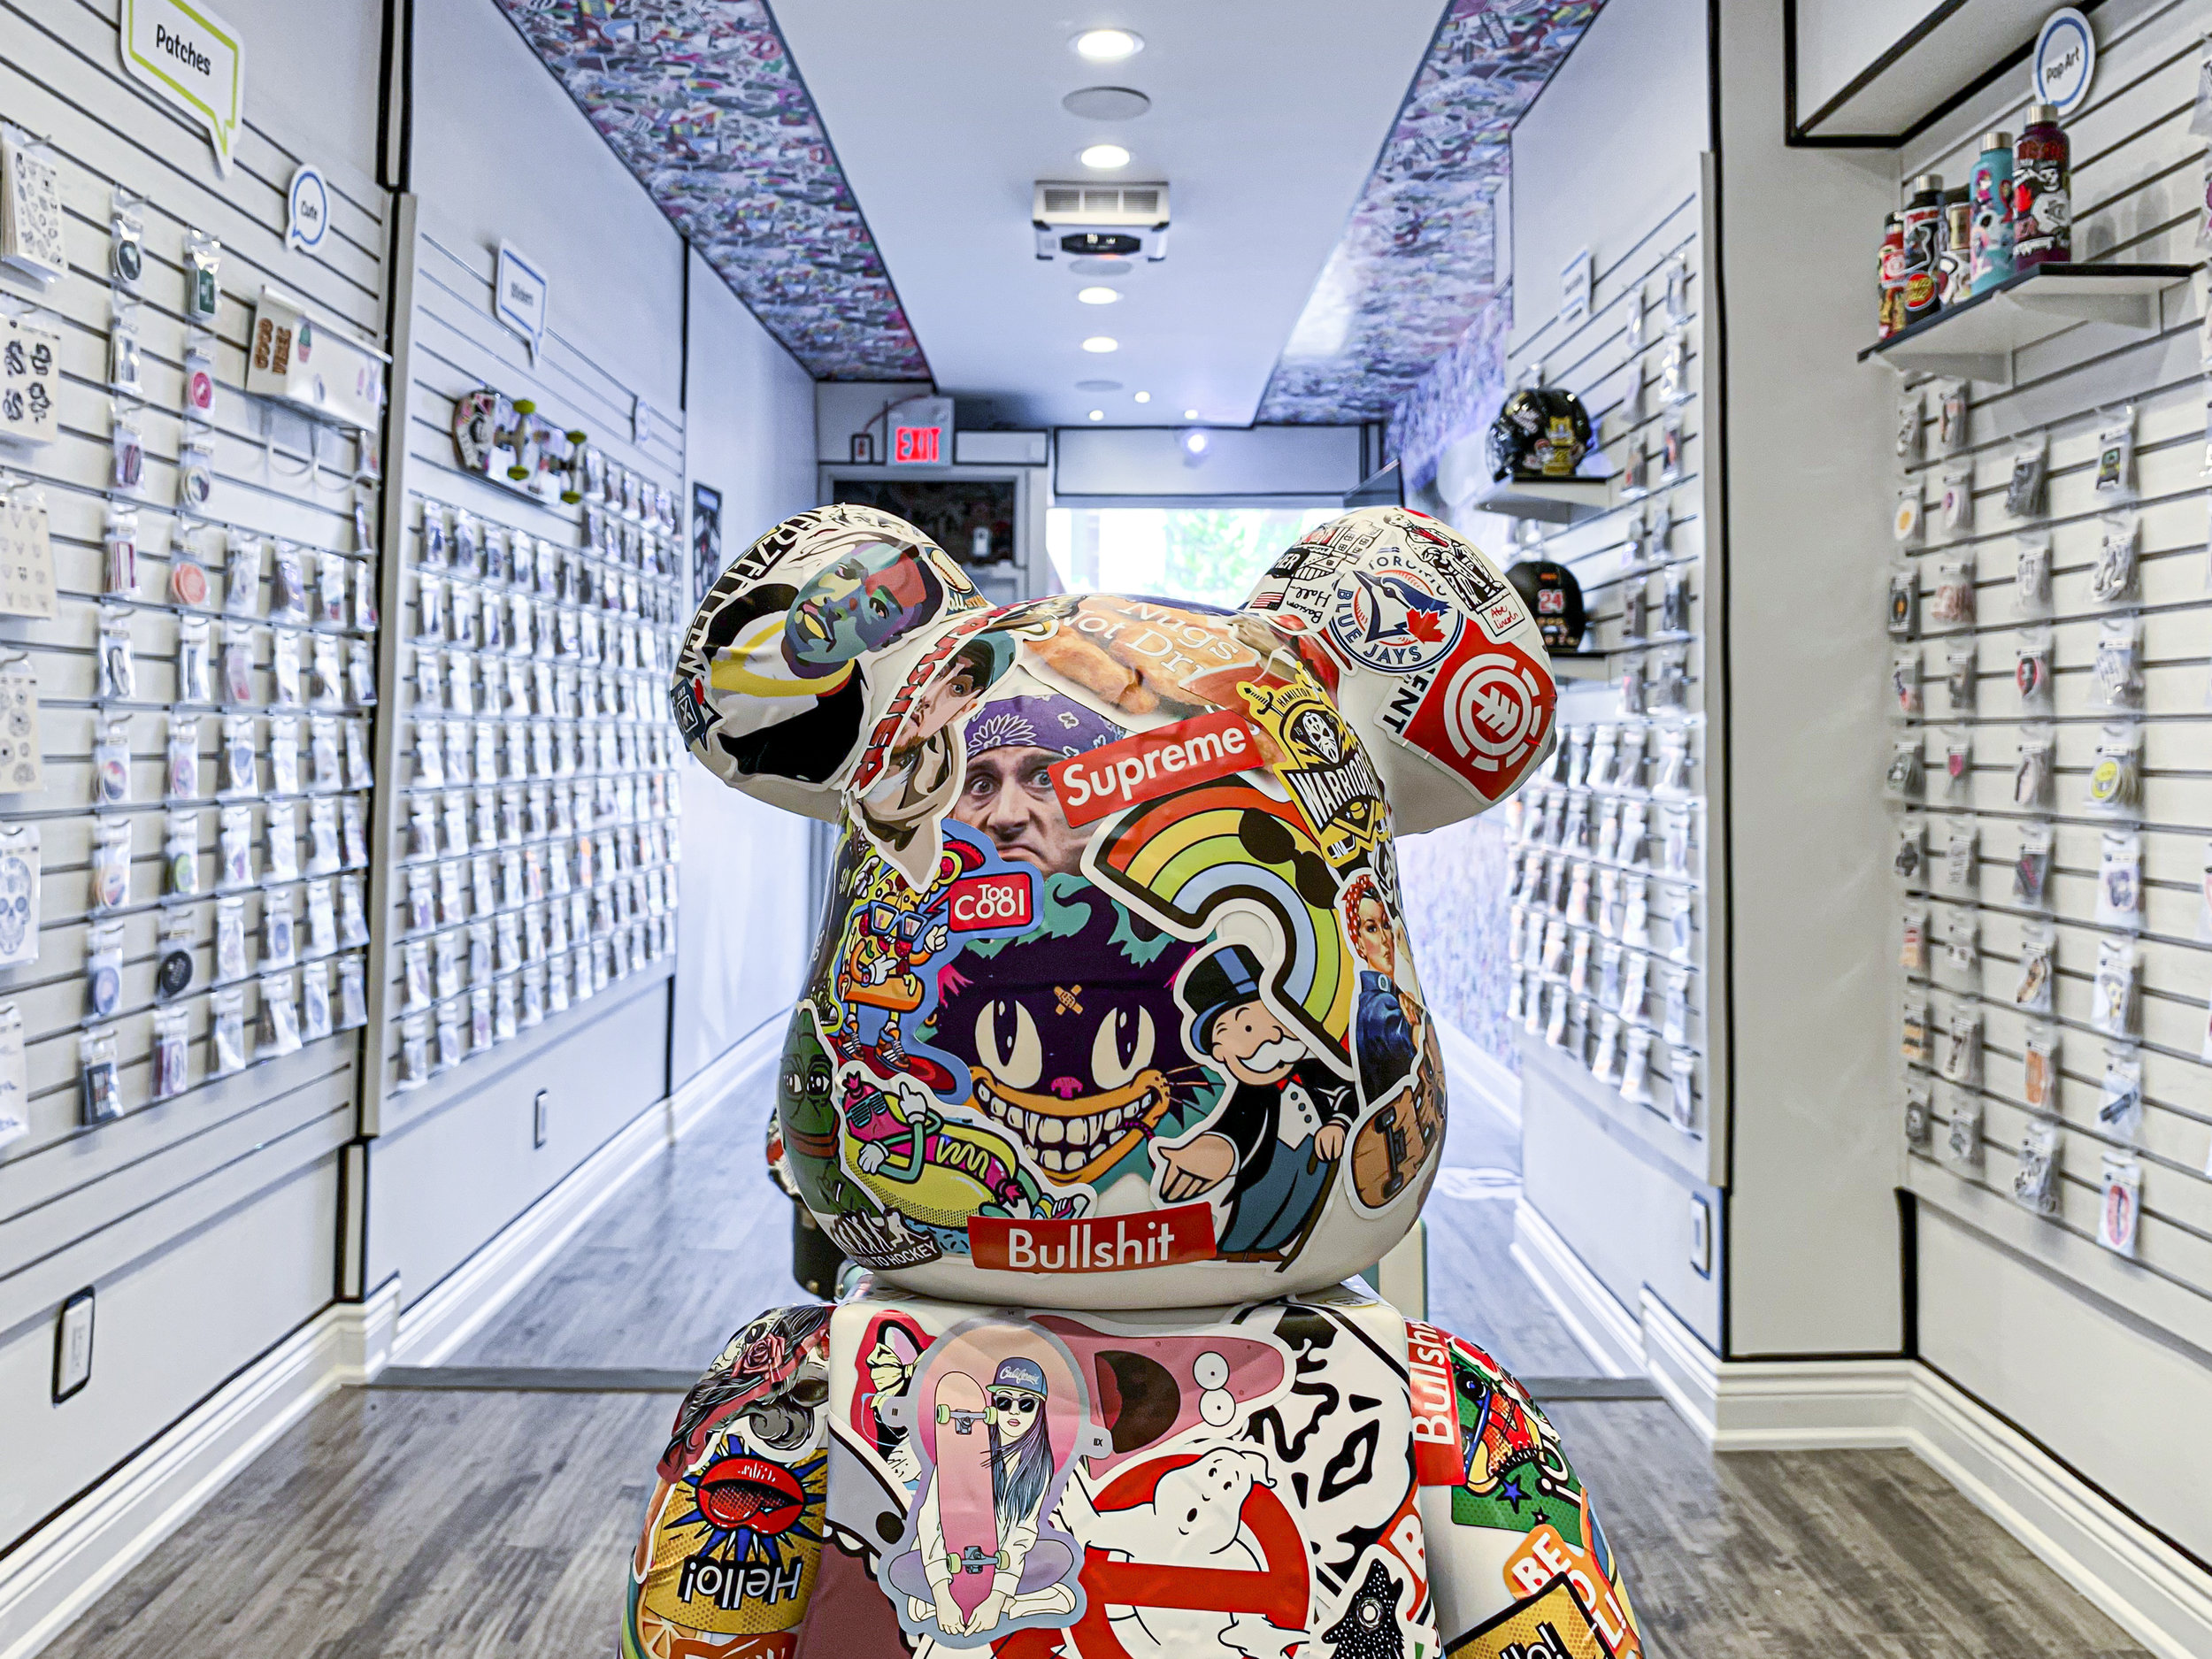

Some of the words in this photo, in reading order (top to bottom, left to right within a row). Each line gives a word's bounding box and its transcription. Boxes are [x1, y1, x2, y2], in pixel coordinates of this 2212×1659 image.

[156, 23, 211, 76] Patches
[2046, 62, 2064, 84] Pop
[2065, 45, 2079, 70] Art
[300, 199, 319, 220] Cute
[895, 426, 941, 463] EXIT
[1336, 588, 1363, 643] BLUE
[1540, 590, 1564, 614] 24
[1119, 603, 1240, 660] Nugs
[1363, 645, 1423, 664] JAYS
[1276, 687, 1311, 708] HAMILTON
[1063, 727, 1247, 807] Supreme
[873, 1256, 889, 1267] TO
[889, 1240, 938, 1266] HOCKEY
[1009, 1220, 1175, 1269] Bullshit
[1000, 1366, 1041, 1386] California
[684, 1562, 803, 1609] Hello!
